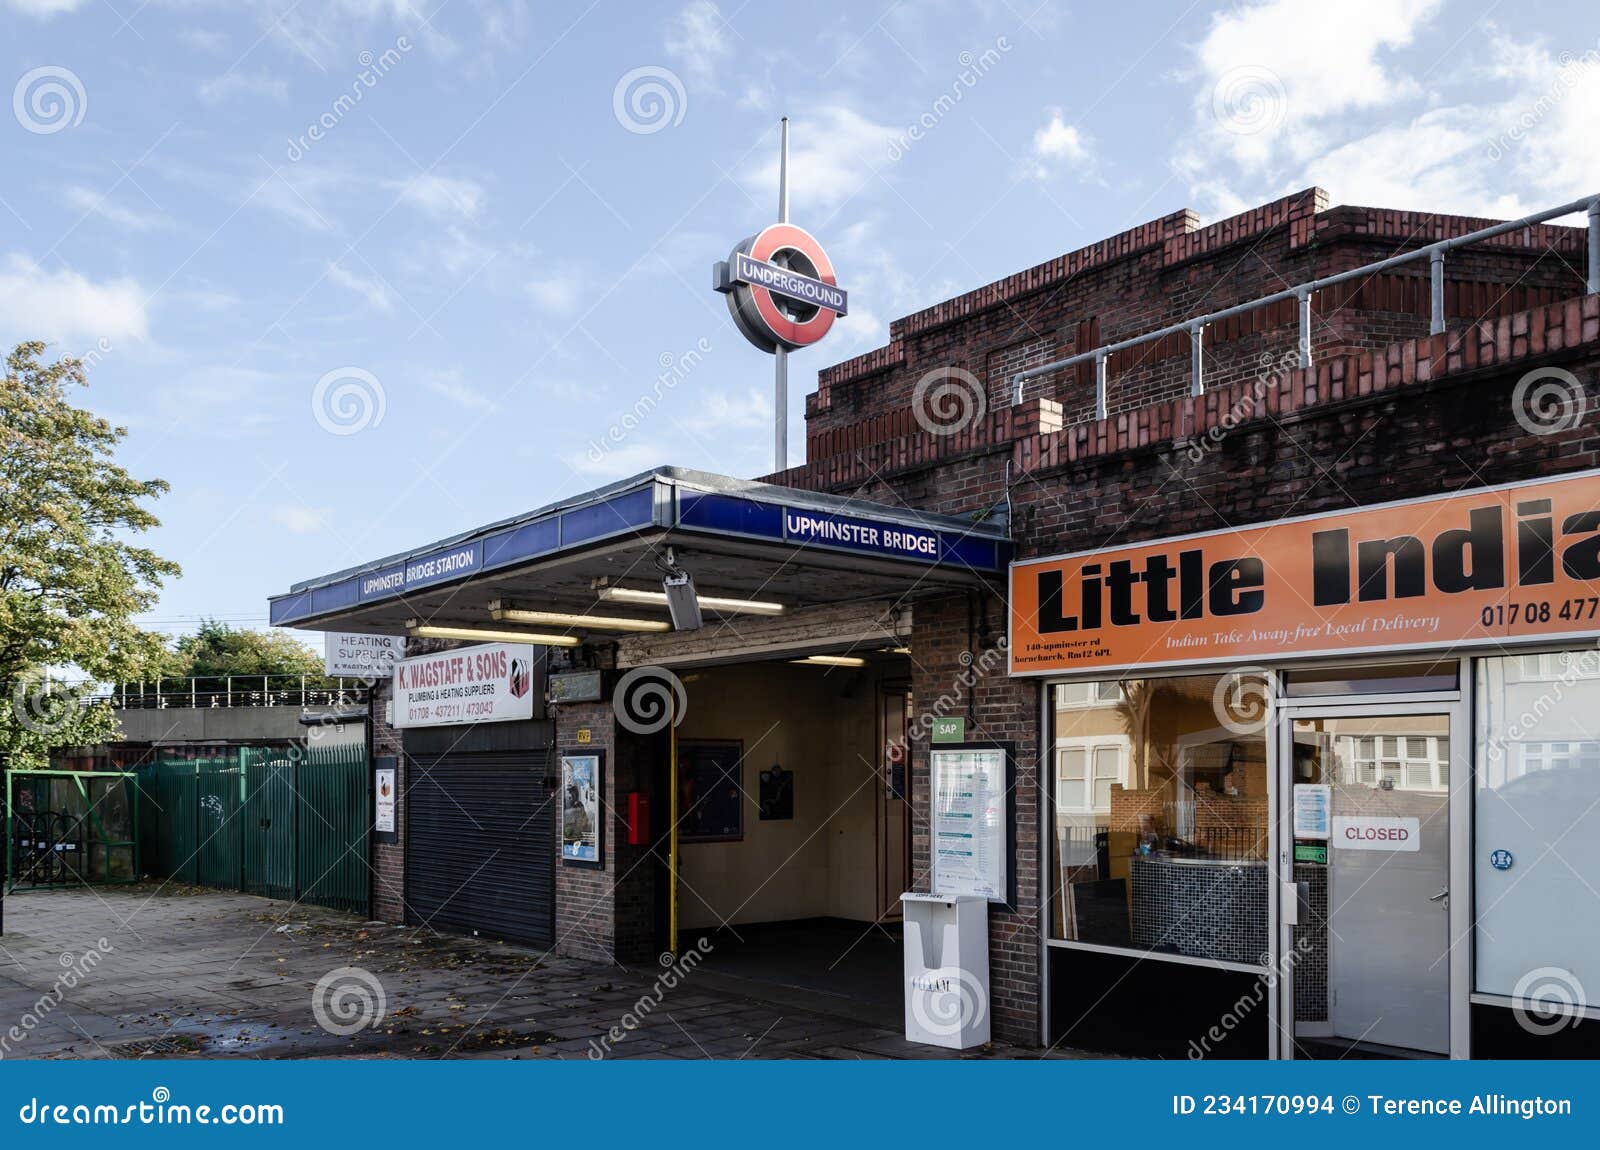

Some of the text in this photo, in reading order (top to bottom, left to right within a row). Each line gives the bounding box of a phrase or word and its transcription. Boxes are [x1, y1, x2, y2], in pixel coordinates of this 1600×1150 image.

[743, 261, 843, 306] UNDERGROUND
[787, 515, 937, 554] UPMINSTER BRIDGE
[363, 550, 474, 594] UPMINSTER BRIDGE STATION
[1037, 549, 1265, 634] Little
[1559, 597, 1600, 621] 477
[341, 636, 392, 648] HEATING
[1090, 638, 1101, 646] rd
[1166, 635, 1208, 649] Indian
[1213, 628, 1245, 645] Take
[1326, 617, 1366, 636] Local
[1372, 614, 1441, 633] Delivery
[338, 648, 395, 660] SUPPLIES
[399, 650, 507, 690] K. WAGSTAFF & SONS
[408, 689, 435, 703] PLUMBING
[440, 686, 464, 699] HEATING
[464, 683, 495, 697] SUPPLIERS
[409, 706, 429, 721] 01708
[435, 704, 460, 718] 437211
[466, 700, 493, 716] 473043
[939, 723, 957, 735] SAP
[1345, 827, 1409, 841] CLOSED
